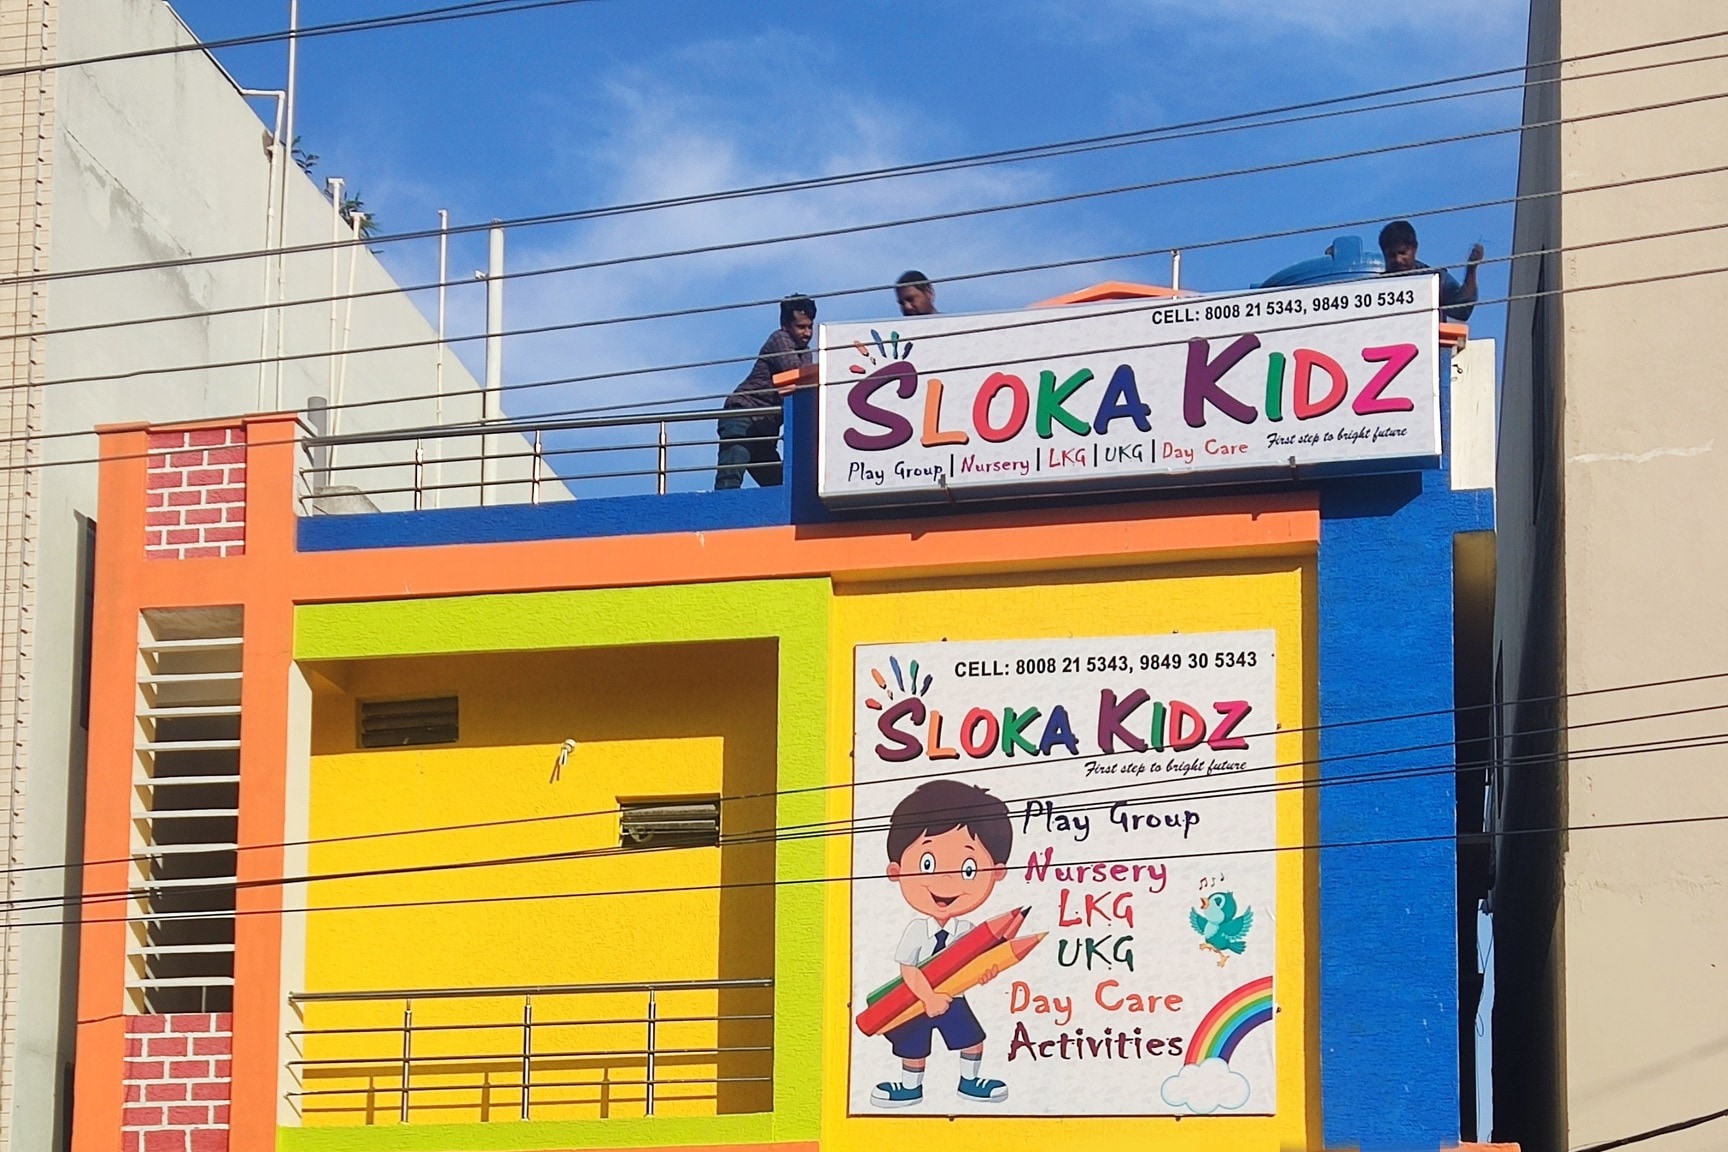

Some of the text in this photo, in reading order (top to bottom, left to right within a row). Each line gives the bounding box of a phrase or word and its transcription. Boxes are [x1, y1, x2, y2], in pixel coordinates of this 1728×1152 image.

[1151, 290, 1415, 325] CELL: 8008 21 5343, 9849 30 5343
[843, 332, 1419, 452] SLOKA KIDZ
[1267, 427, 1407, 449] First step to bright future
[848, 438, 1248, 486] Play Group Nursery LKG UKG Day Care
[954, 651, 1257, 678] CELL: 8008 21 5343, 9849 30 5343
[875, 688, 1252, 762] SLOKA KIDZ
[1084, 758, 1247, 777] First step to bright future
[1022, 799, 1201, 841] Play Group
[1025, 847, 1168, 893] Nursery
[1059, 889, 1134, 928] LKG
[1057, 934, 1135, 972] UKG
[1009, 979, 1184, 1025] Day Care
[1007, 1021, 1184, 1062] Activities
